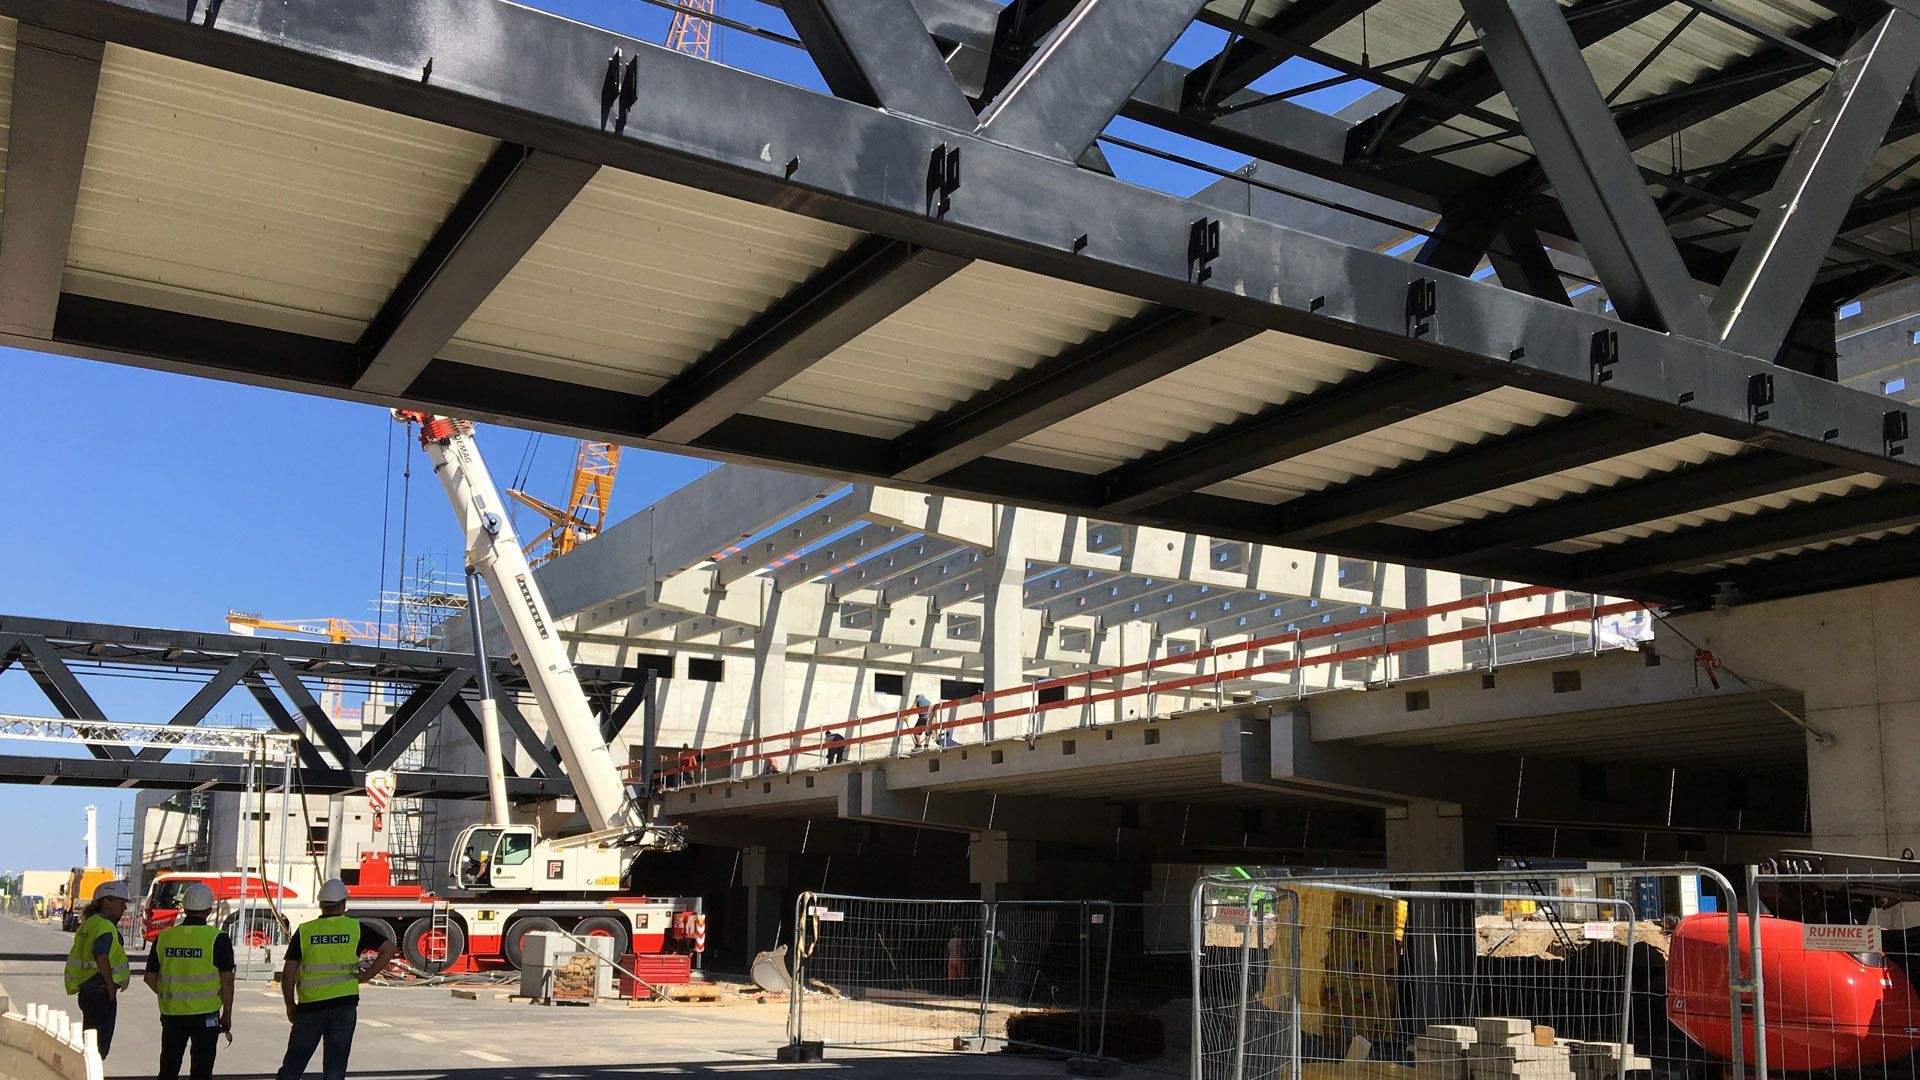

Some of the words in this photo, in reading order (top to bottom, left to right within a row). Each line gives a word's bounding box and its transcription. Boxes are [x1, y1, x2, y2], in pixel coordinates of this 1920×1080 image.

[455, 435, 472, 463] DEMAG
[549, 861, 562, 878] F
[637, 915, 646, 927] F
[1809, 926, 1863, 938] RUHNKE
[312, 935, 349, 944] ZECH
[166, 948, 202, 958] ZECH
